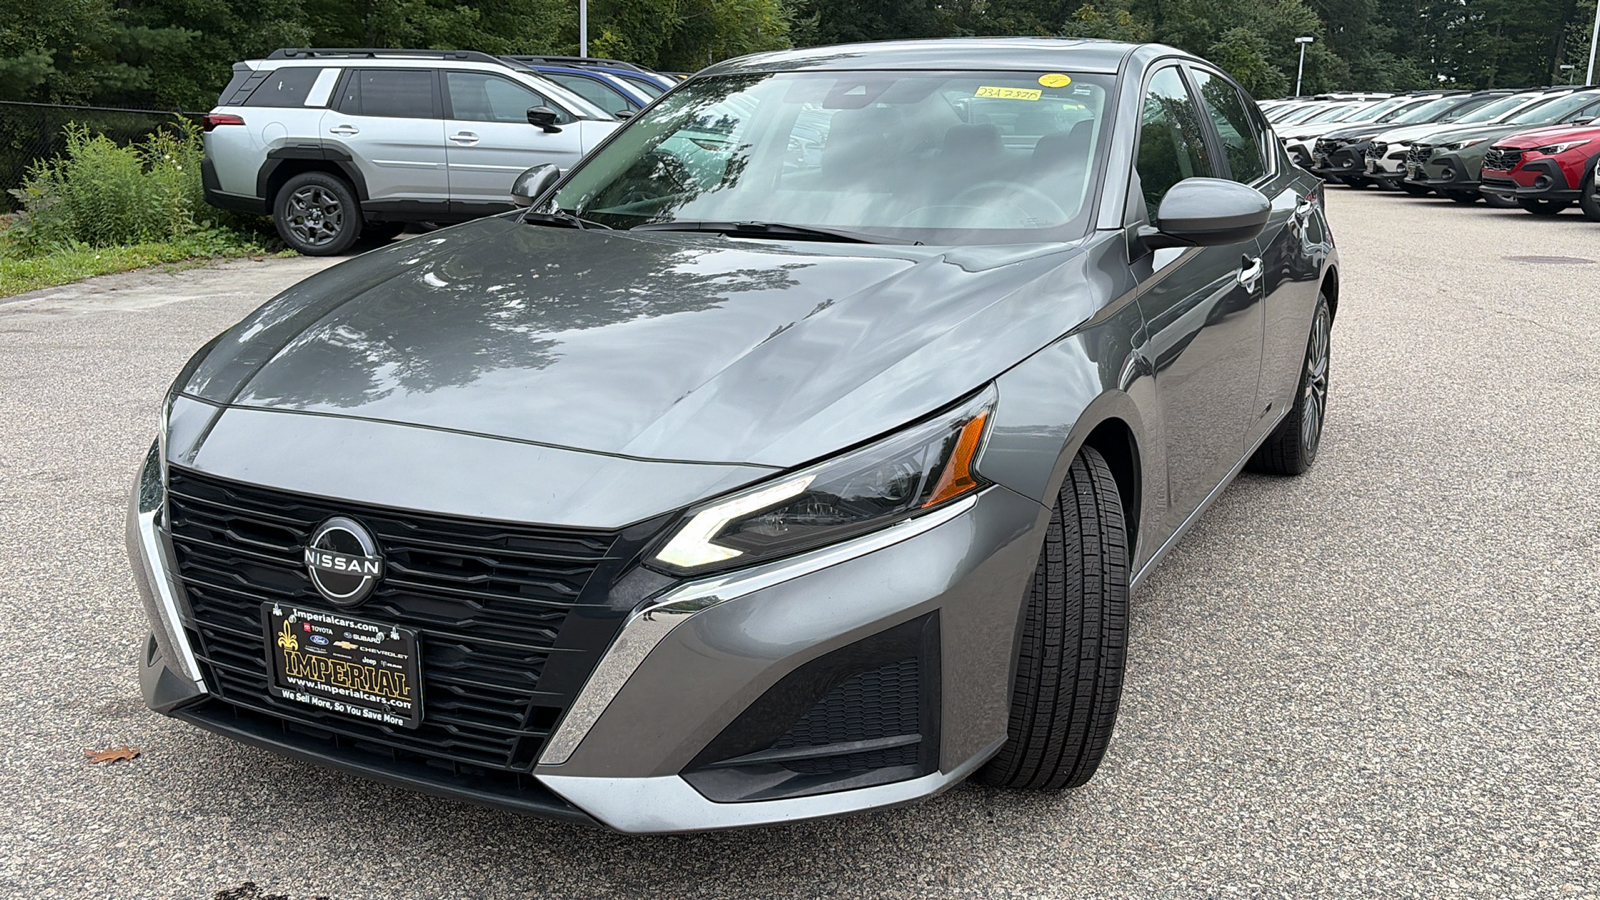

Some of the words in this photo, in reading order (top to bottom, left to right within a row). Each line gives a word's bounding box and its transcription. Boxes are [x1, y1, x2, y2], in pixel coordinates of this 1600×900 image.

[305, 549, 379, 574] NISSAN
[292, 608, 379, 633] Imperialcars.com
[311, 625, 334, 635] TOYOTA
[359, 646, 409, 660] CHEVROLET
[362, 656, 377, 666] Jeep
[284, 649, 411, 701] IMPERIAL
[281, 689, 295, 701] We
[295, 691, 310, 704] Sell
[311, 695, 333, 710] More,
[334, 702, 345, 713] So
[346, 704, 362, 716] You
[362, 709, 382, 721] Save
[383, 714, 404, 726] More
